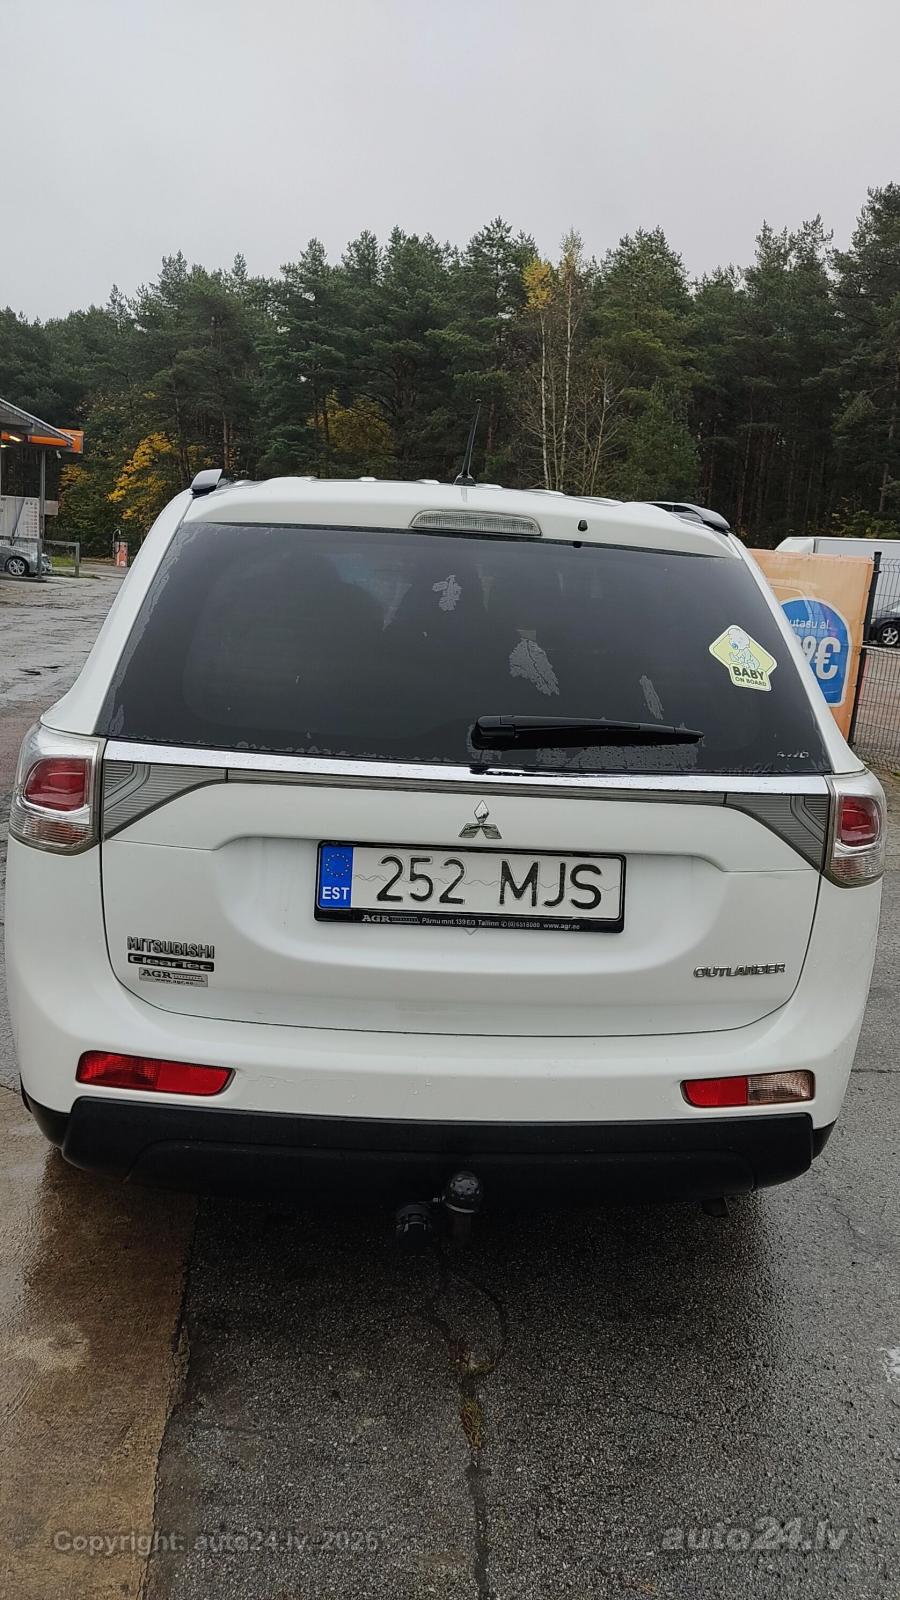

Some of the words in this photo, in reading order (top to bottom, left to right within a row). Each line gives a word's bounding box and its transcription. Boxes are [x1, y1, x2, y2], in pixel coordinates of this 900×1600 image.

[733, 666, 764, 680] BABY
[746, 678, 767, 687] BOARD
[376, 856, 465, 904] 252
[499, 860, 603, 910] MJS
[322, 886, 350, 900] EST
[362, 914, 391, 923] AGR
[127, 936, 215, 959] MITSUBISHI
[129, 954, 213, 971] ClearTec
[141, 969, 173, 979] AGR
[693, 962, 786, 978] OUTLANDER
